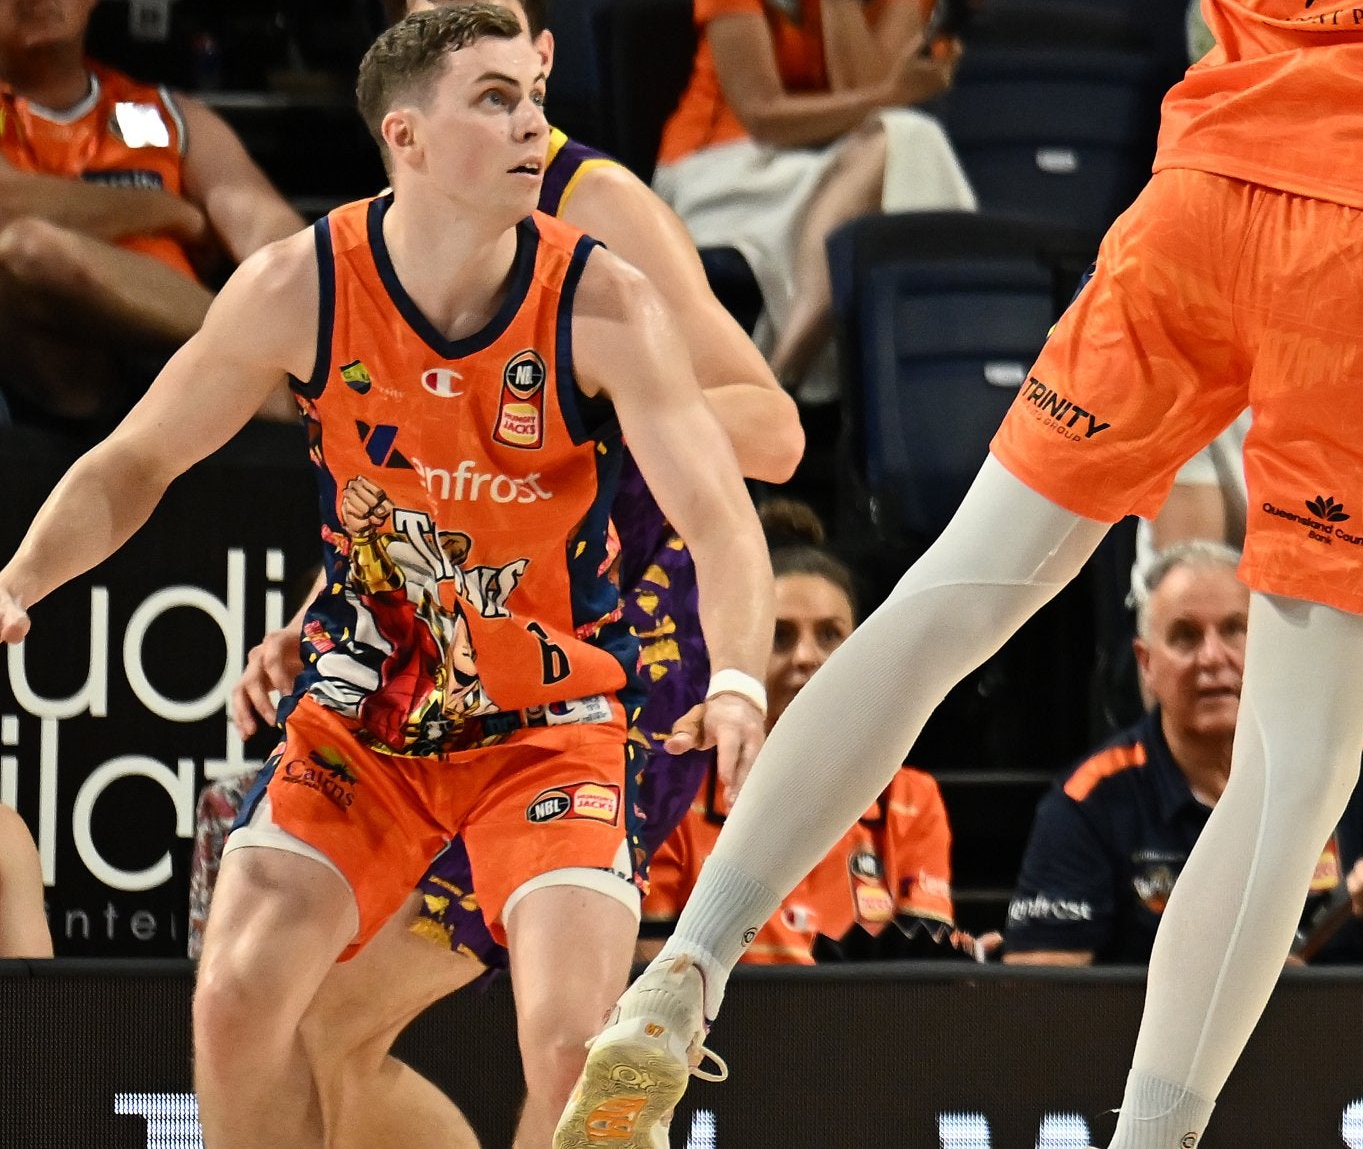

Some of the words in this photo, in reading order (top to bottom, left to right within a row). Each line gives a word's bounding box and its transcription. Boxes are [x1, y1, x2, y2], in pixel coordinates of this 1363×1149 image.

[1022, 376, 1111, 439] TRINITY
[1262, 502, 1334, 535] Queensland
[1308, 530, 1333, 545] Bank
[534, 798, 563, 821] NBL
